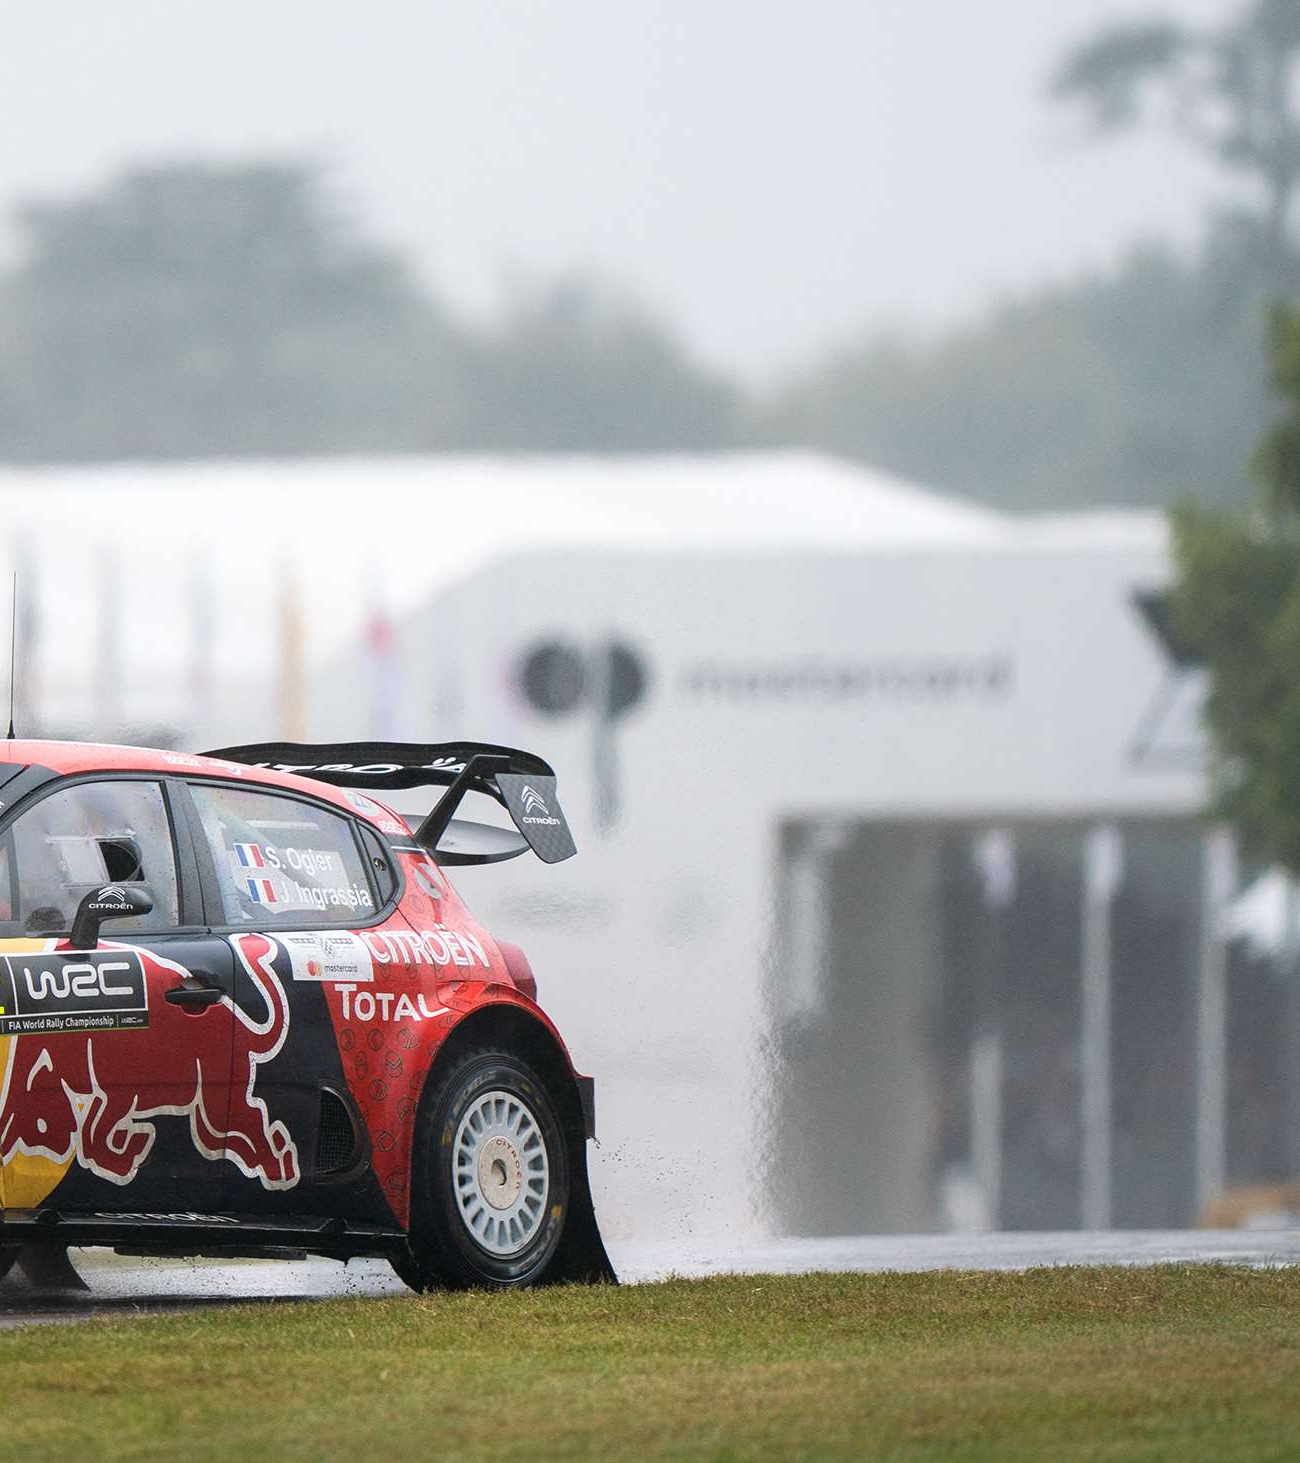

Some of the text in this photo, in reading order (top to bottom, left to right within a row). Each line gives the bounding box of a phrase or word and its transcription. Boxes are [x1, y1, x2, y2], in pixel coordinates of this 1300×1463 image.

[265, 847, 333, 876] S. Ogier
[280, 881, 373, 910] J. Ingrassia
[358, 923, 490, 968] CITROËN
[23, 962, 134, 1000] WRC
[333, 983, 451, 1022] TOTAL
[8, 1015, 114, 1031] FIA World Rally Championship
